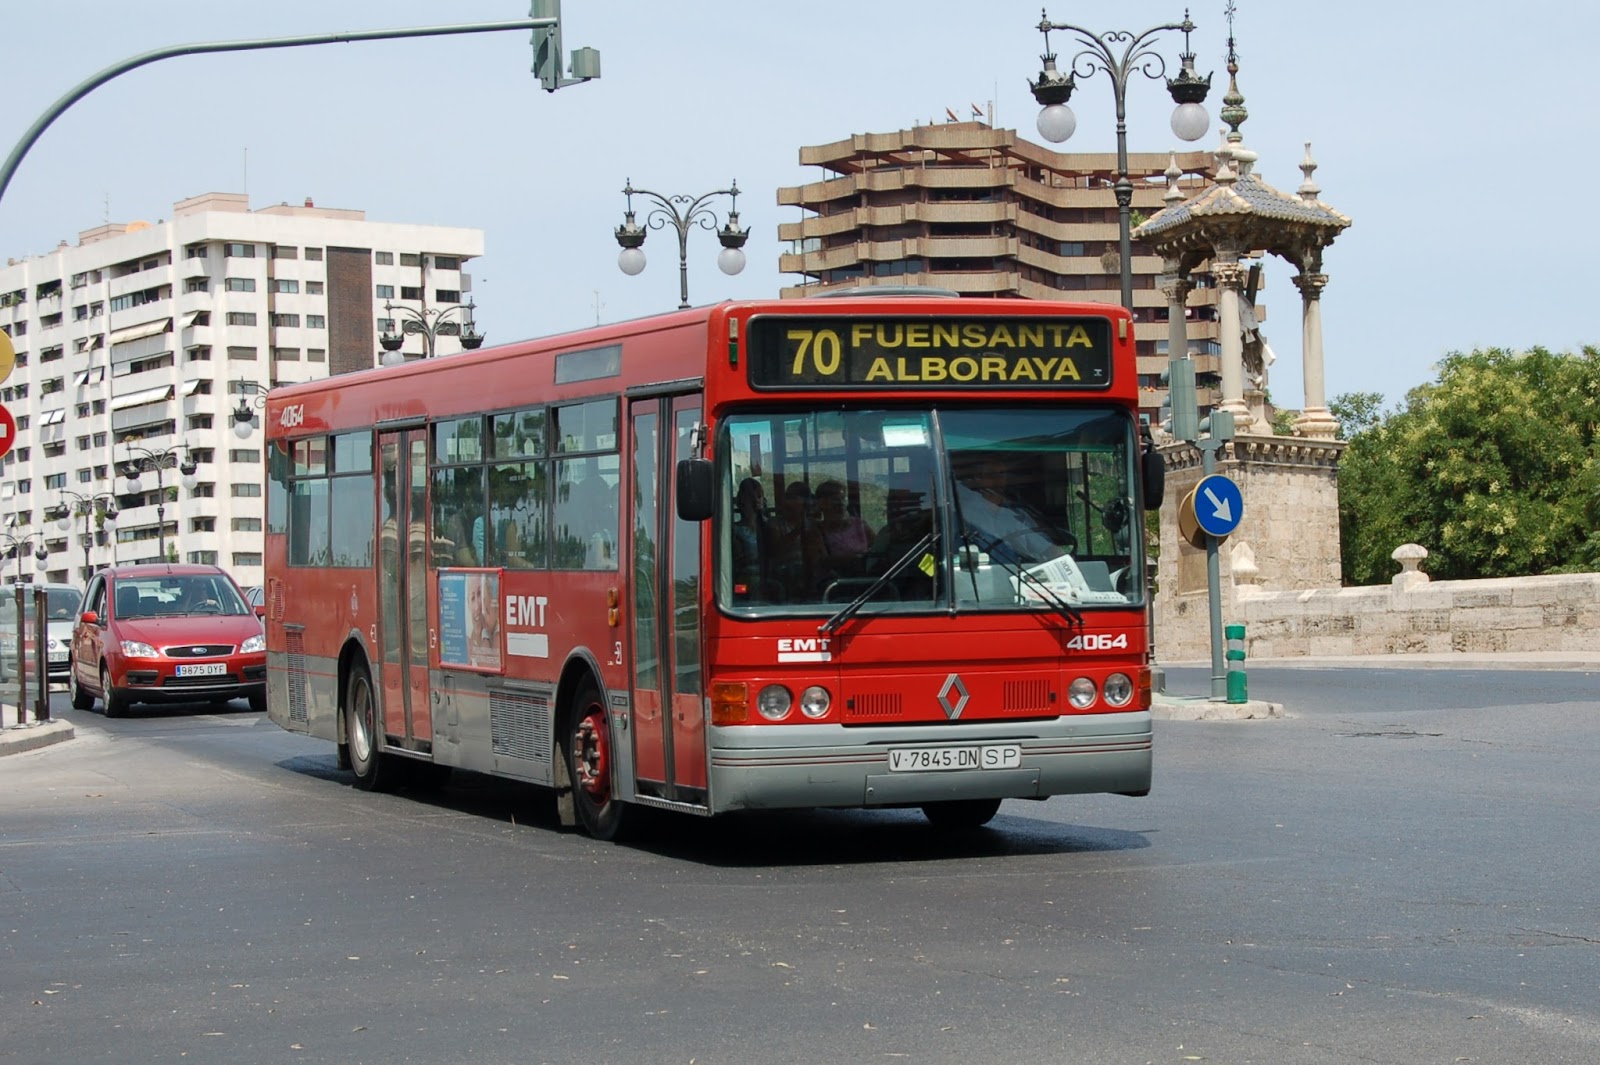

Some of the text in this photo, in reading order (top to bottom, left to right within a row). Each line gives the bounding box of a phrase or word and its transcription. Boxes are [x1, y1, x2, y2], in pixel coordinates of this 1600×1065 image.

[852, 324, 1092, 348] FUENSANTA
[788, 330, 840, 374] 70
[866, 357, 1081, 381] ALBORAYA
[281, 404, 304, 427] 4064
[506, 595, 547, 627] EMT
[777, 638, 831, 651] EMT
[1066, 633, 1128, 650] 4064
[181, 665, 224, 675] 9875 DYF
[985, 748, 1017, 765] SP
